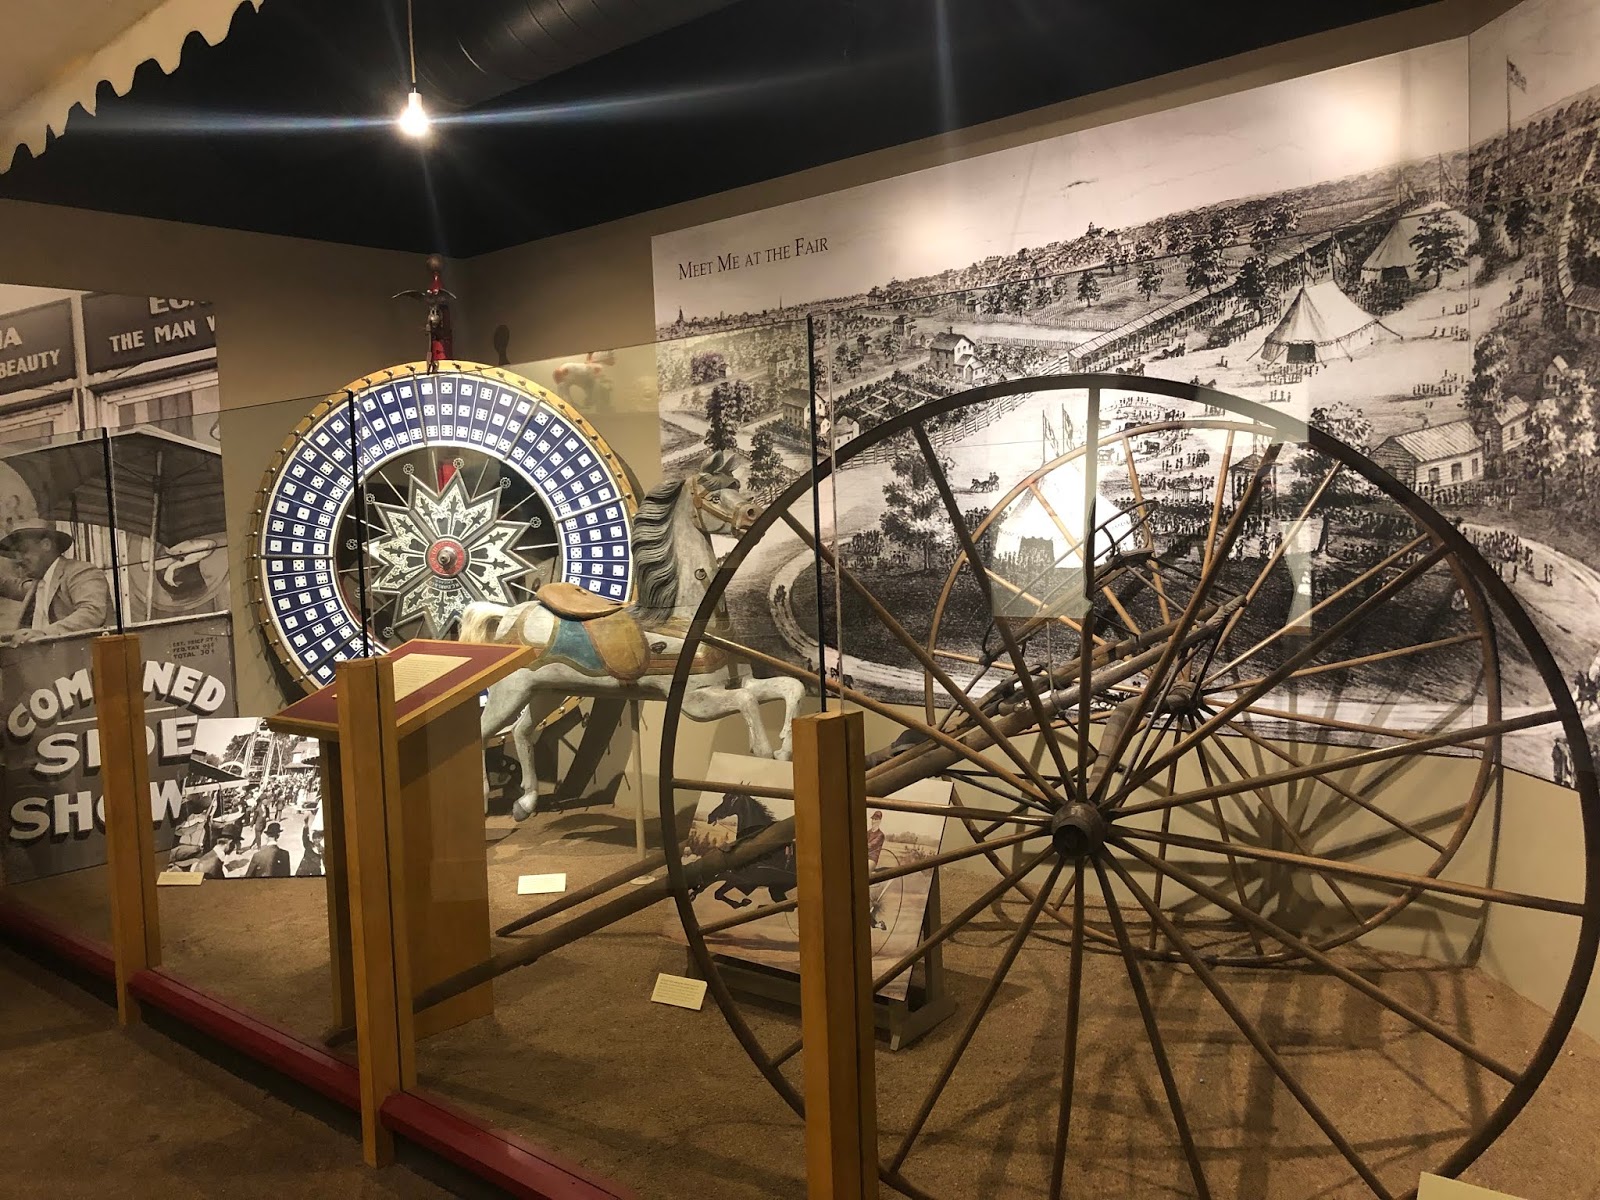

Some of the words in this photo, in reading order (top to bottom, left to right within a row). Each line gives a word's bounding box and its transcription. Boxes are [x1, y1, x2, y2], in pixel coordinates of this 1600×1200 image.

[678, 261, 713, 280] MEET
[717, 253, 740, 273] ME
[744, 251, 762, 267] AT
[765, 245, 791, 263] THE
[795, 237, 829, 257] FAIR
[109, 330, 145, 353] THE
[154, 319, 197, 343] MAN
[0, 348, 60, 379] BEAUTY
[8, 660, 226, 737] COMNED
[10, 779, 183, 840] SHW
